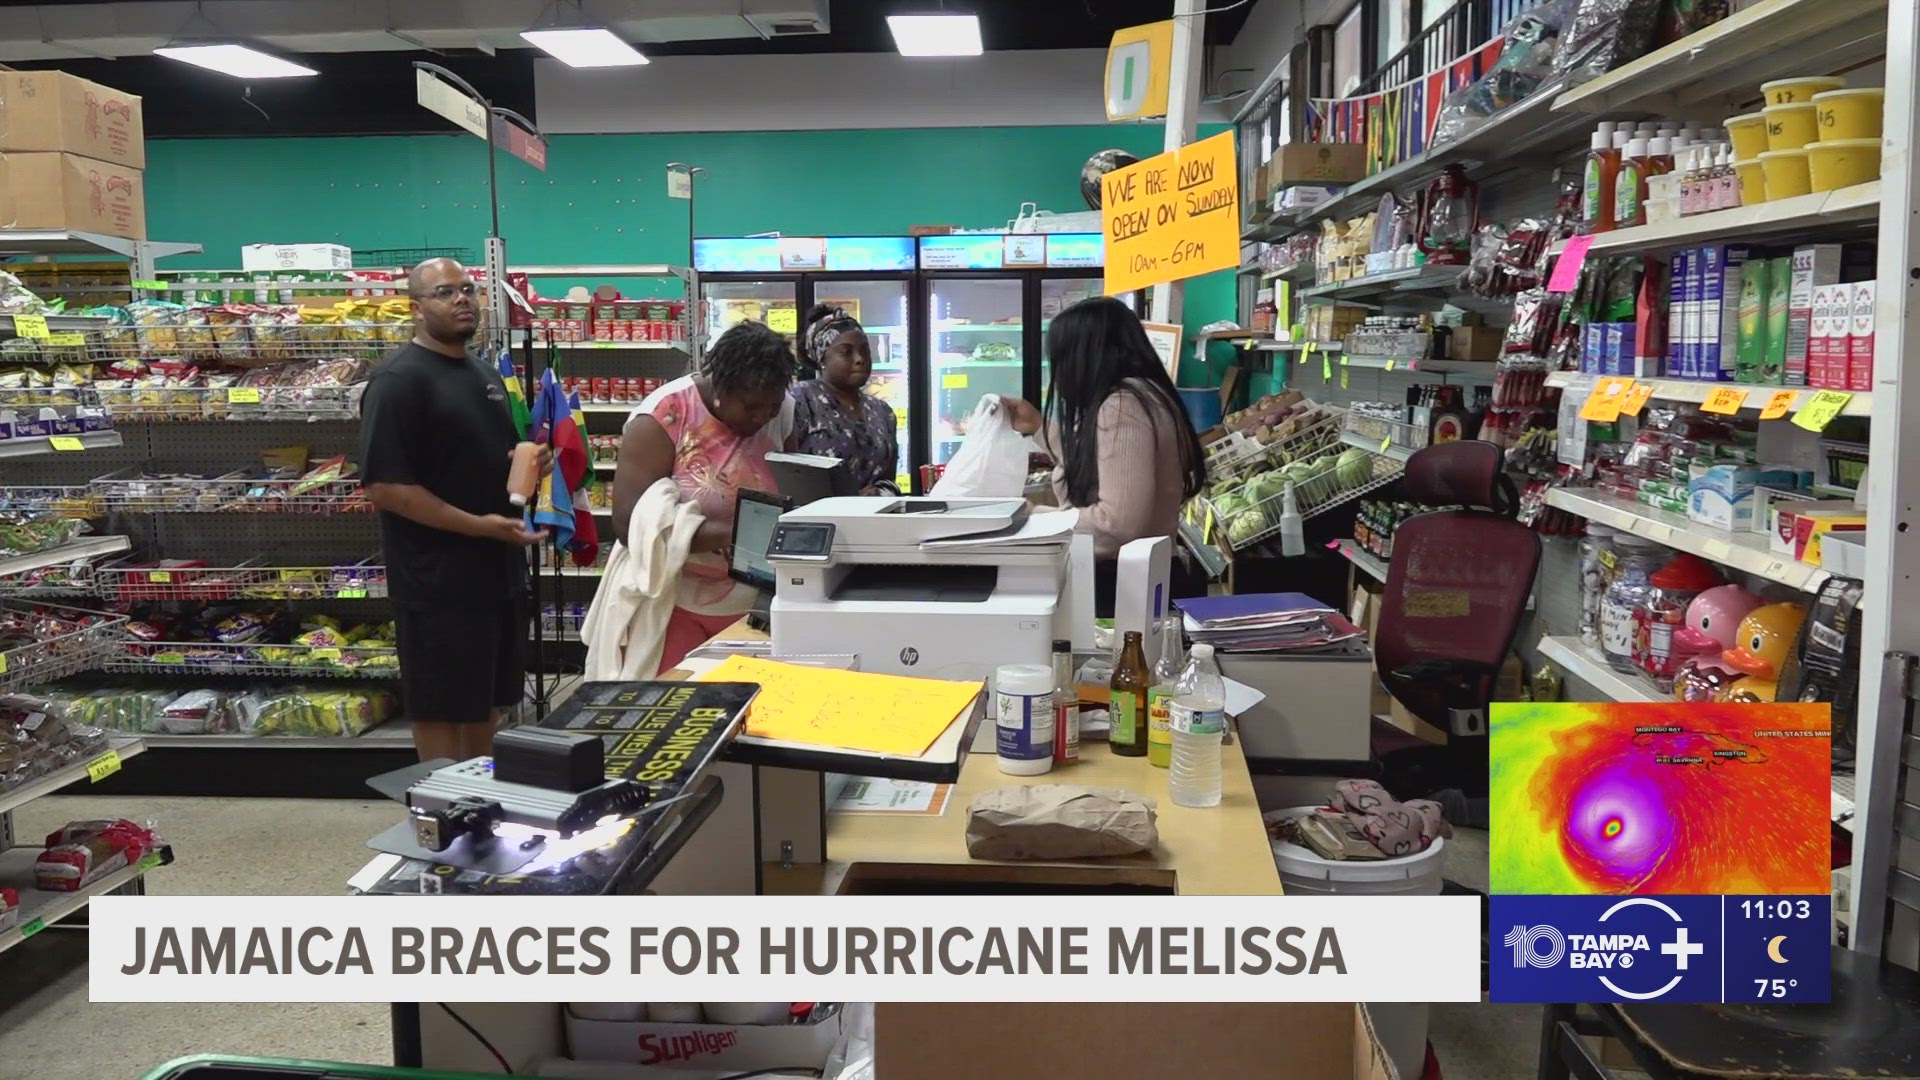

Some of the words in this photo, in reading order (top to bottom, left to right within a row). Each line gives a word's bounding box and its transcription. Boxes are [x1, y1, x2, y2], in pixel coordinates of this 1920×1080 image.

[1108, 172, 1137, 208] WE
[1146, 168, 1168, 196] ARE
[1178, 156, 1215, 190] NOW
[1112, 208, 1150, 240] OPEN
[1157, 201, 1178, 226] ON
[1186, 185, 1236, 218] SUNDAY
[900, 647, 919, 666] hp
[618, 691, 638, 702] TO
[669, 687, 697, 708] MON
[595, 714, 615, 726] TO
[648, 710, 677, 729] TUE
[622, 732, 656, 755] WED
[636, 707, 727, 782] BUSINESS
[638, 1029, 737, 1066] Supligen
